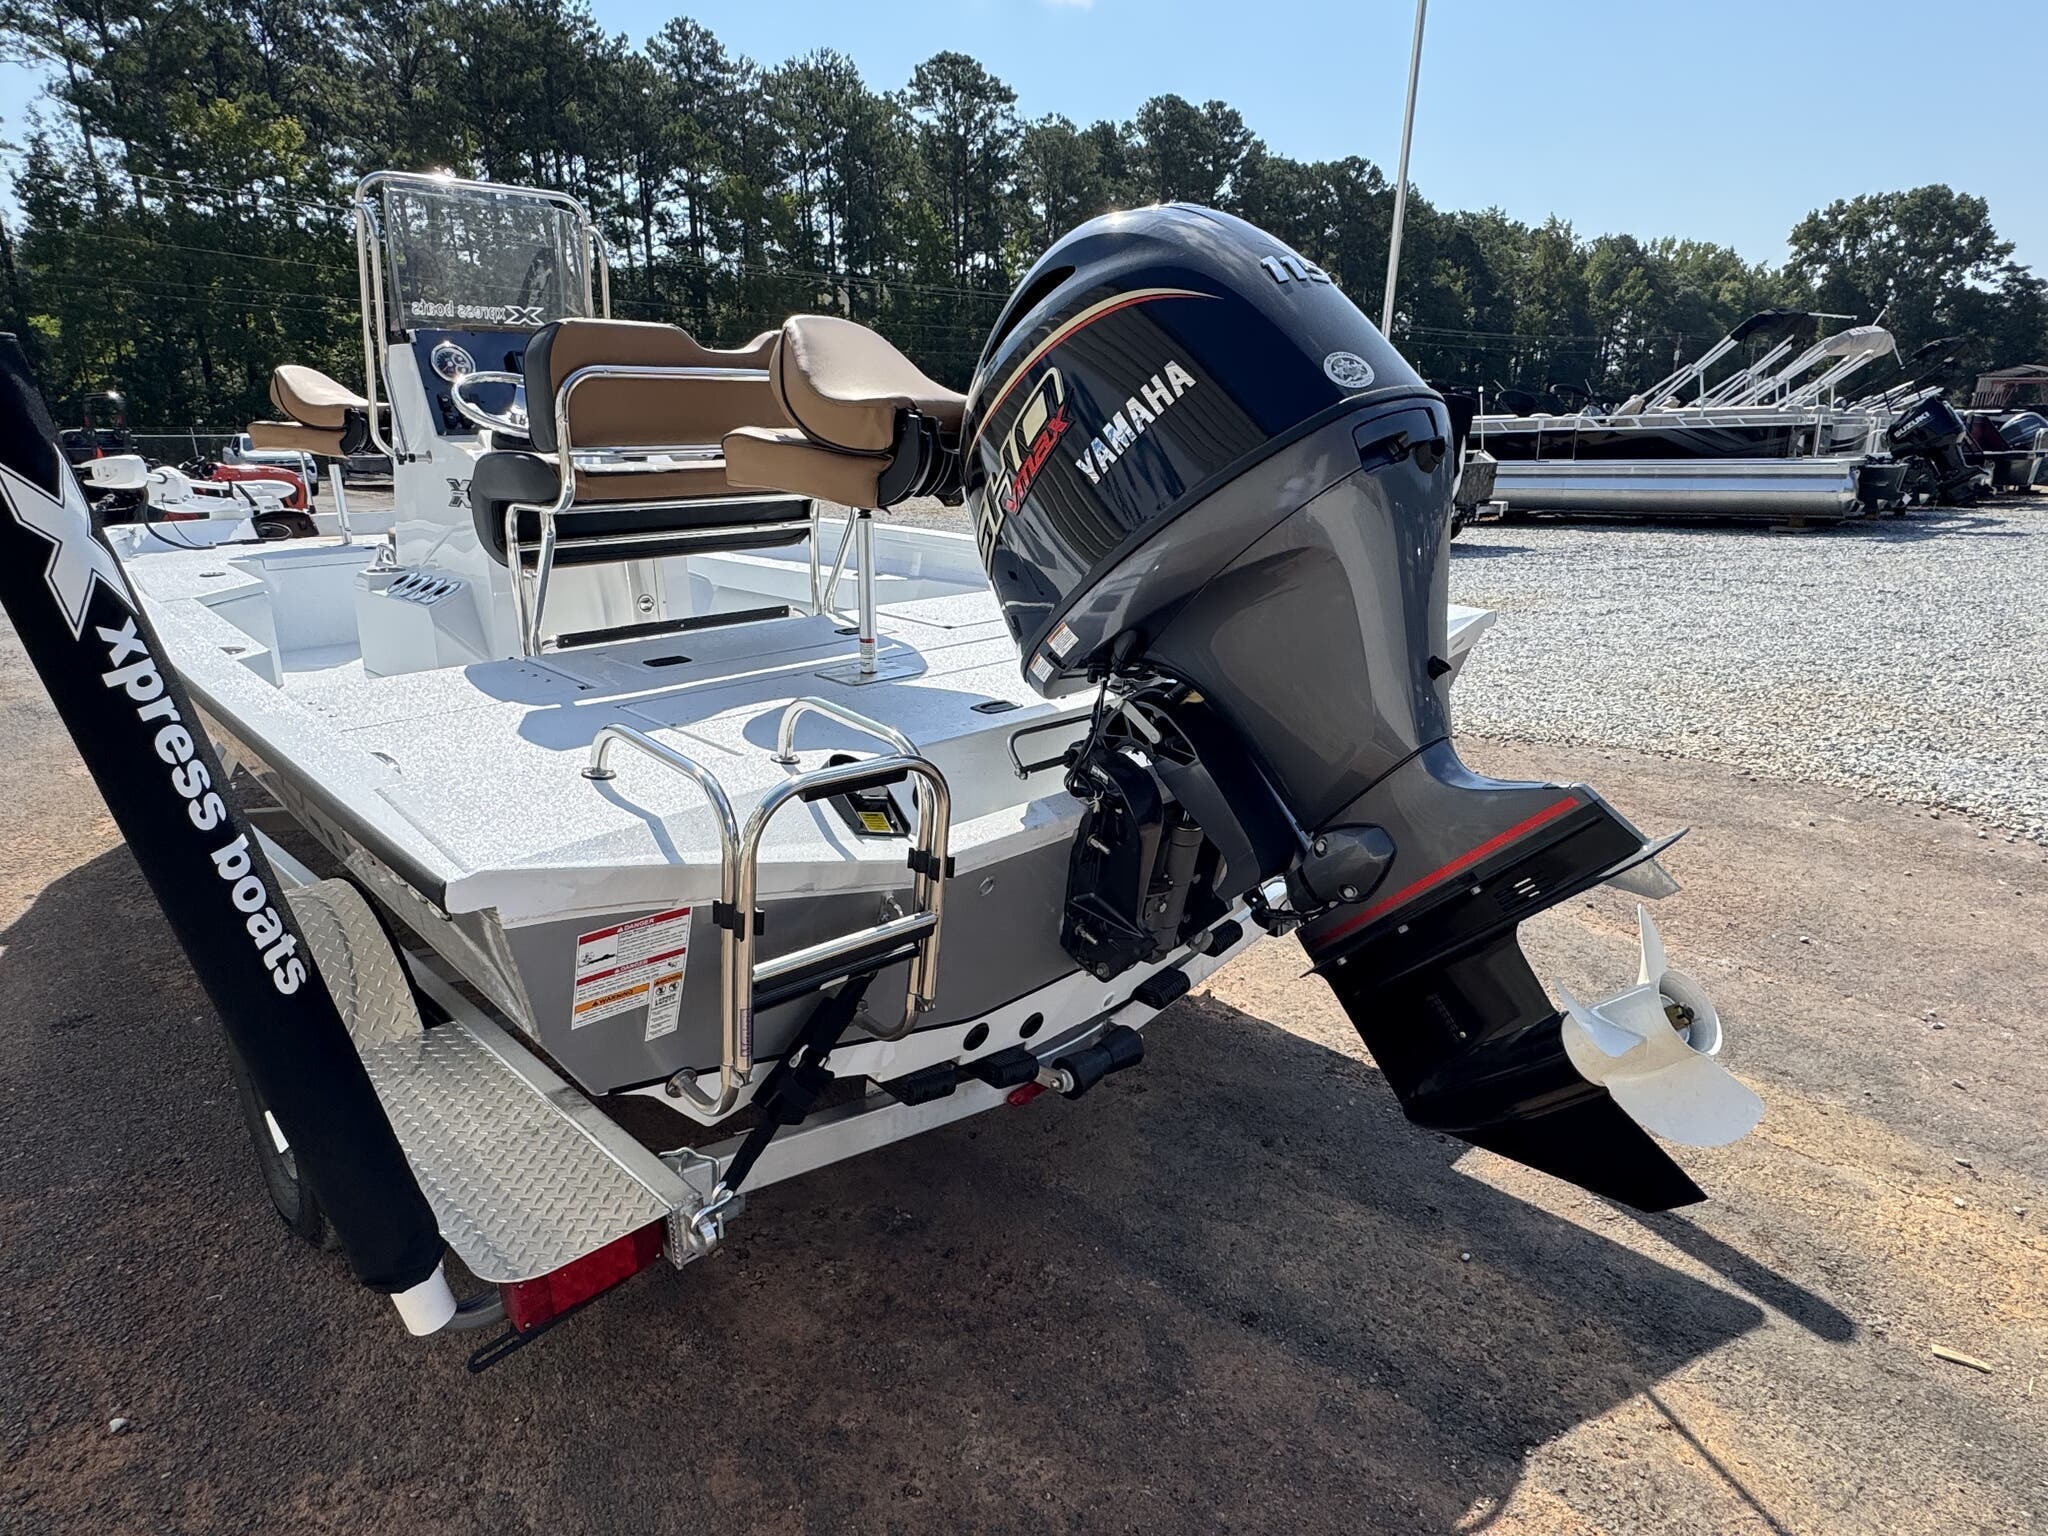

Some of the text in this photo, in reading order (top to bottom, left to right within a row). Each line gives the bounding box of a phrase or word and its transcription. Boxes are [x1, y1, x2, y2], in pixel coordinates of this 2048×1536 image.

[1075, 360, 1197, 484] YAMAHA
[1893, 411, 1931, 438] SUZUKI
[95, 615, 228, 832] xpress
[210, 832, 307, 996] boats
[624, 918, 655, 930] DANGER
[600, 988, 634, 1005] WARNING
